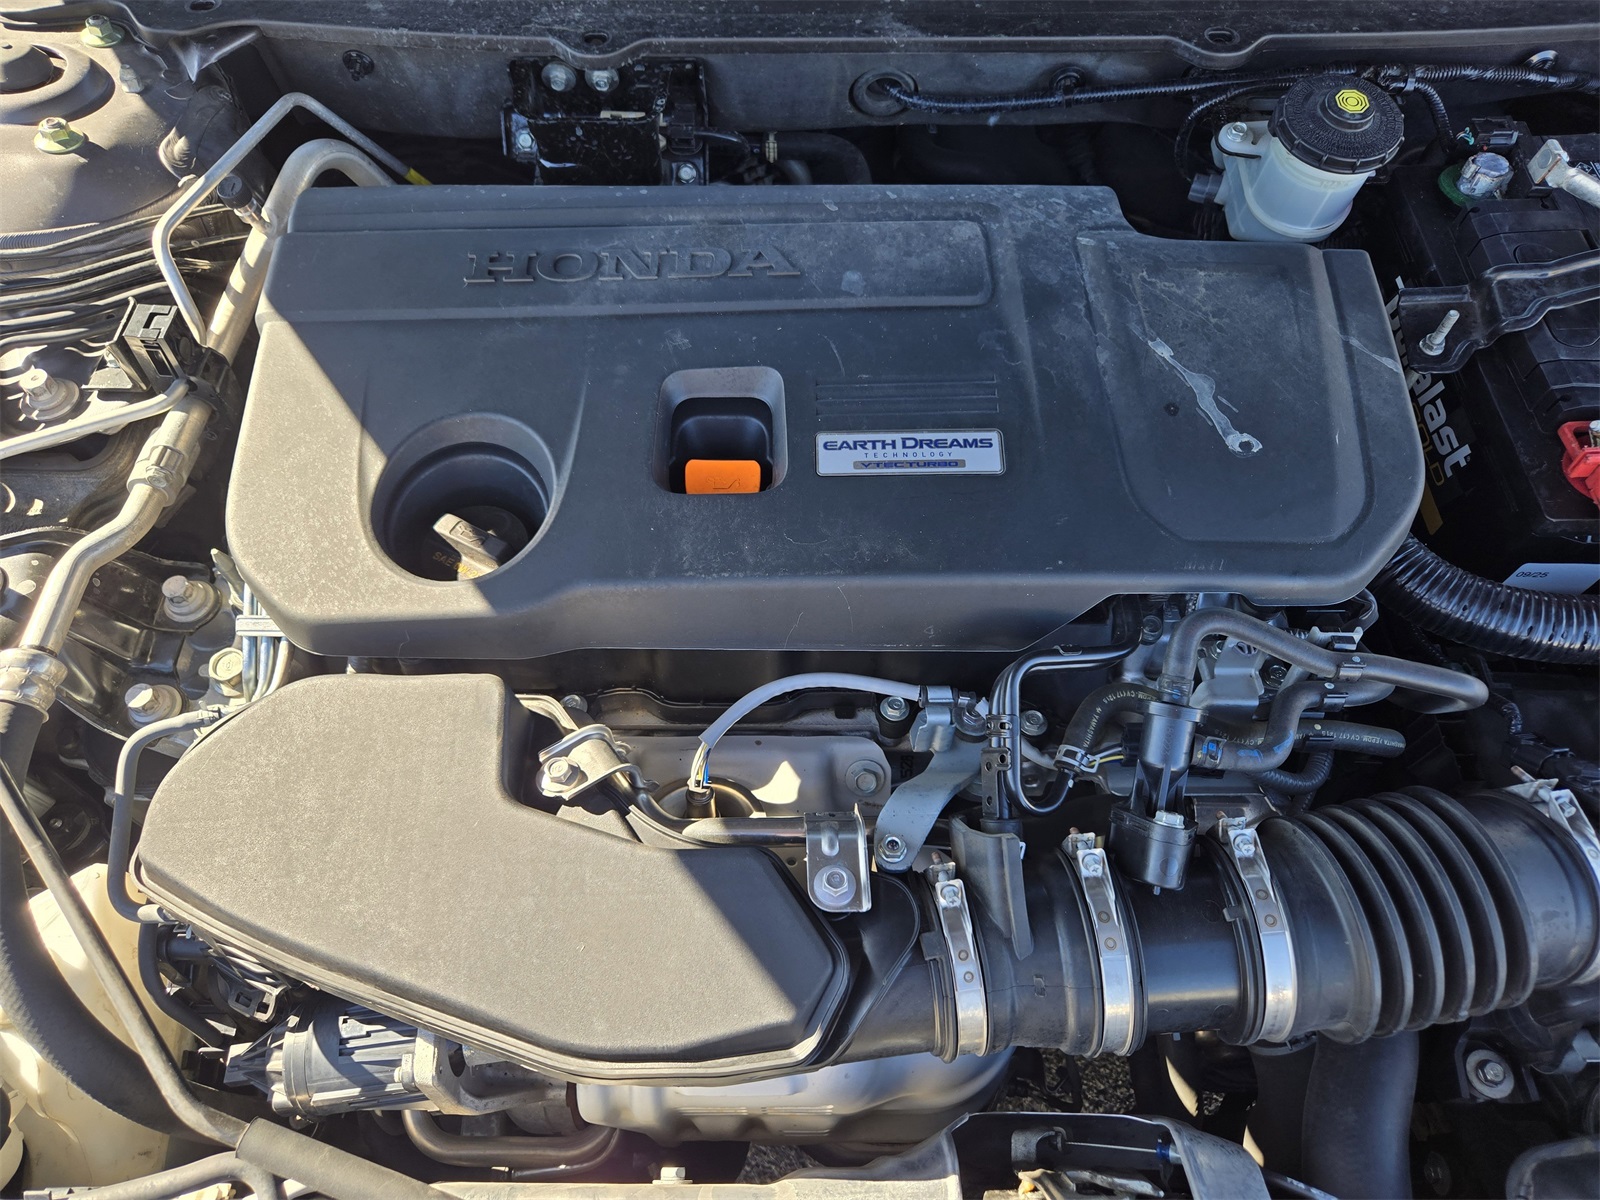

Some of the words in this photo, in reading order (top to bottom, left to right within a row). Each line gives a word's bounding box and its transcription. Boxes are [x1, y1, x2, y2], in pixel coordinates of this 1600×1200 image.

[463, 248, 801, 284] HONDA
[823, 439, 897, 451] EARTH
[901, 437, 994, 450] DREAMS
[864, 451, 953, 459] TECHNOLOGY
